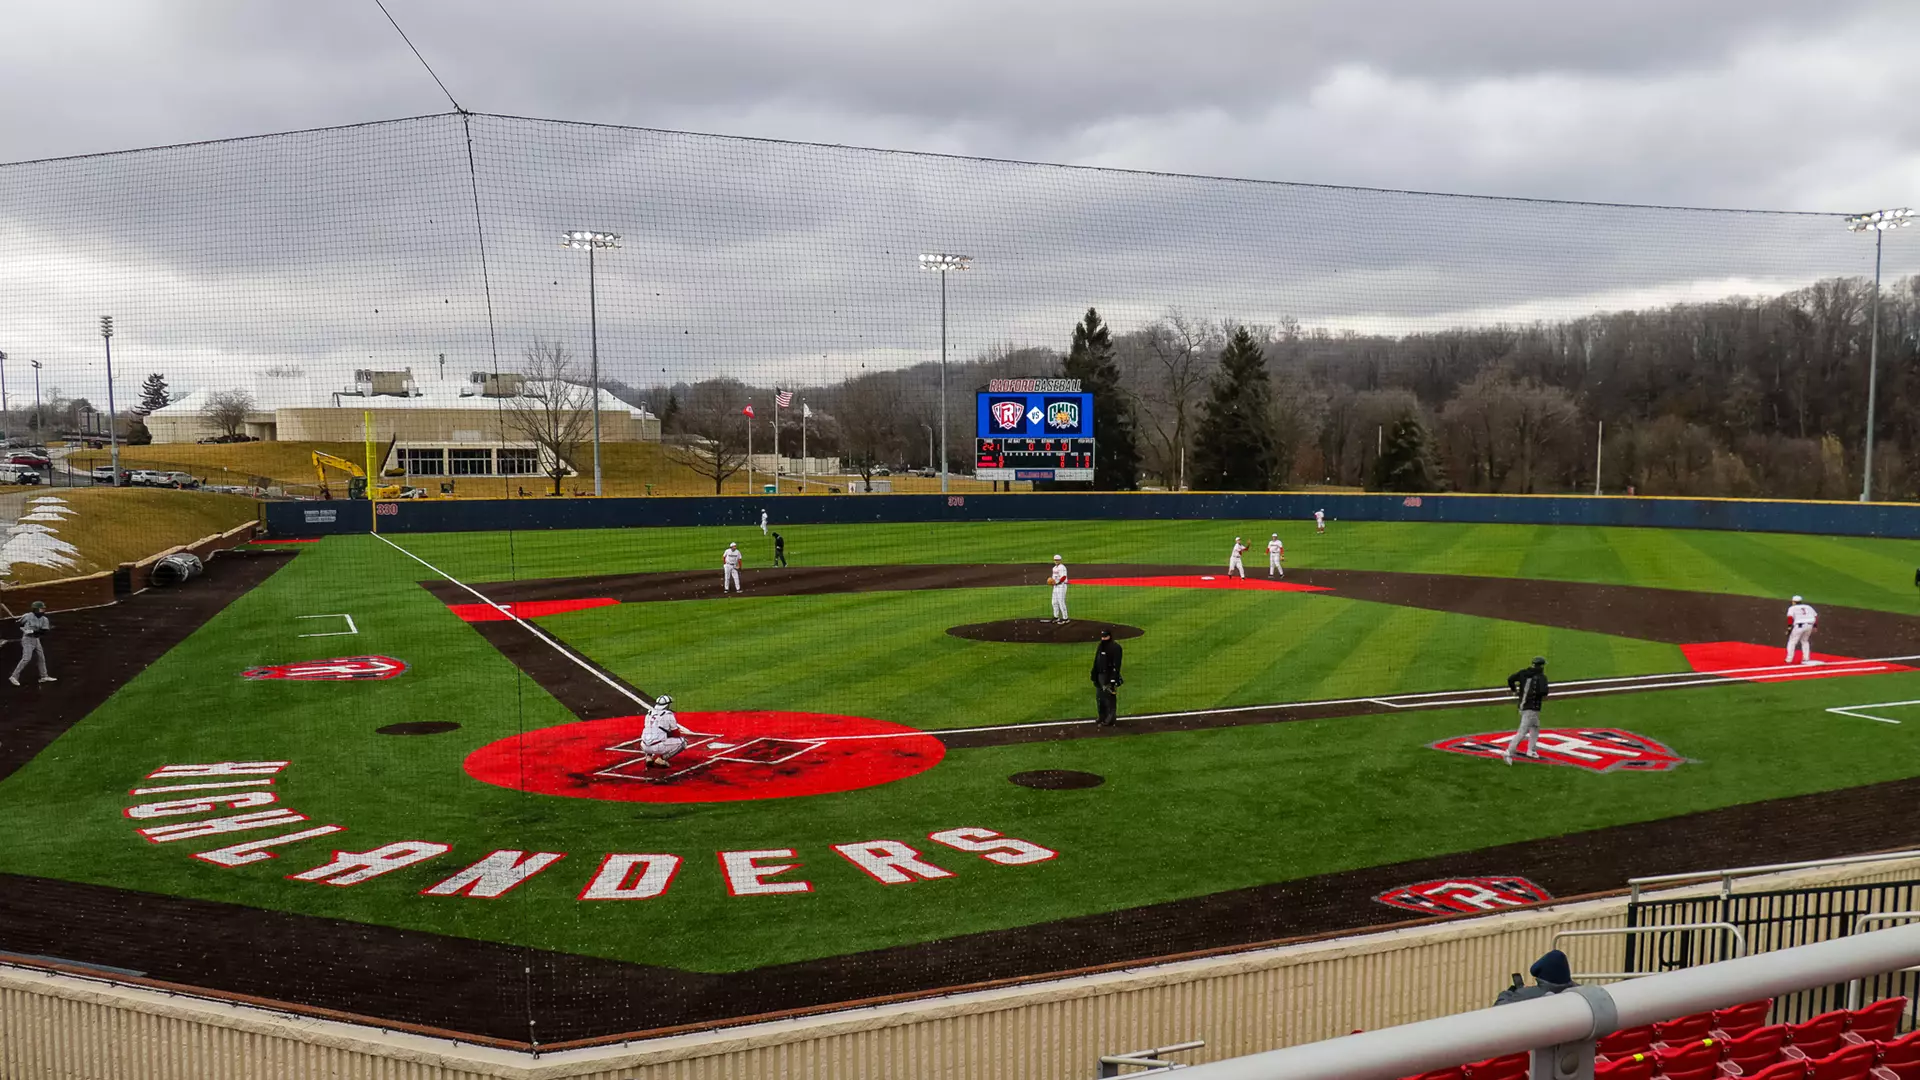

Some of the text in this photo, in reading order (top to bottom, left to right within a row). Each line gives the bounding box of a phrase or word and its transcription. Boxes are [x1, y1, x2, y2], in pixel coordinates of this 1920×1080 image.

[948, 496, 964, 506] 370
[376, 504, 398, 515] 330
[123, 760, 1060, 904] HIGHLANDERS
